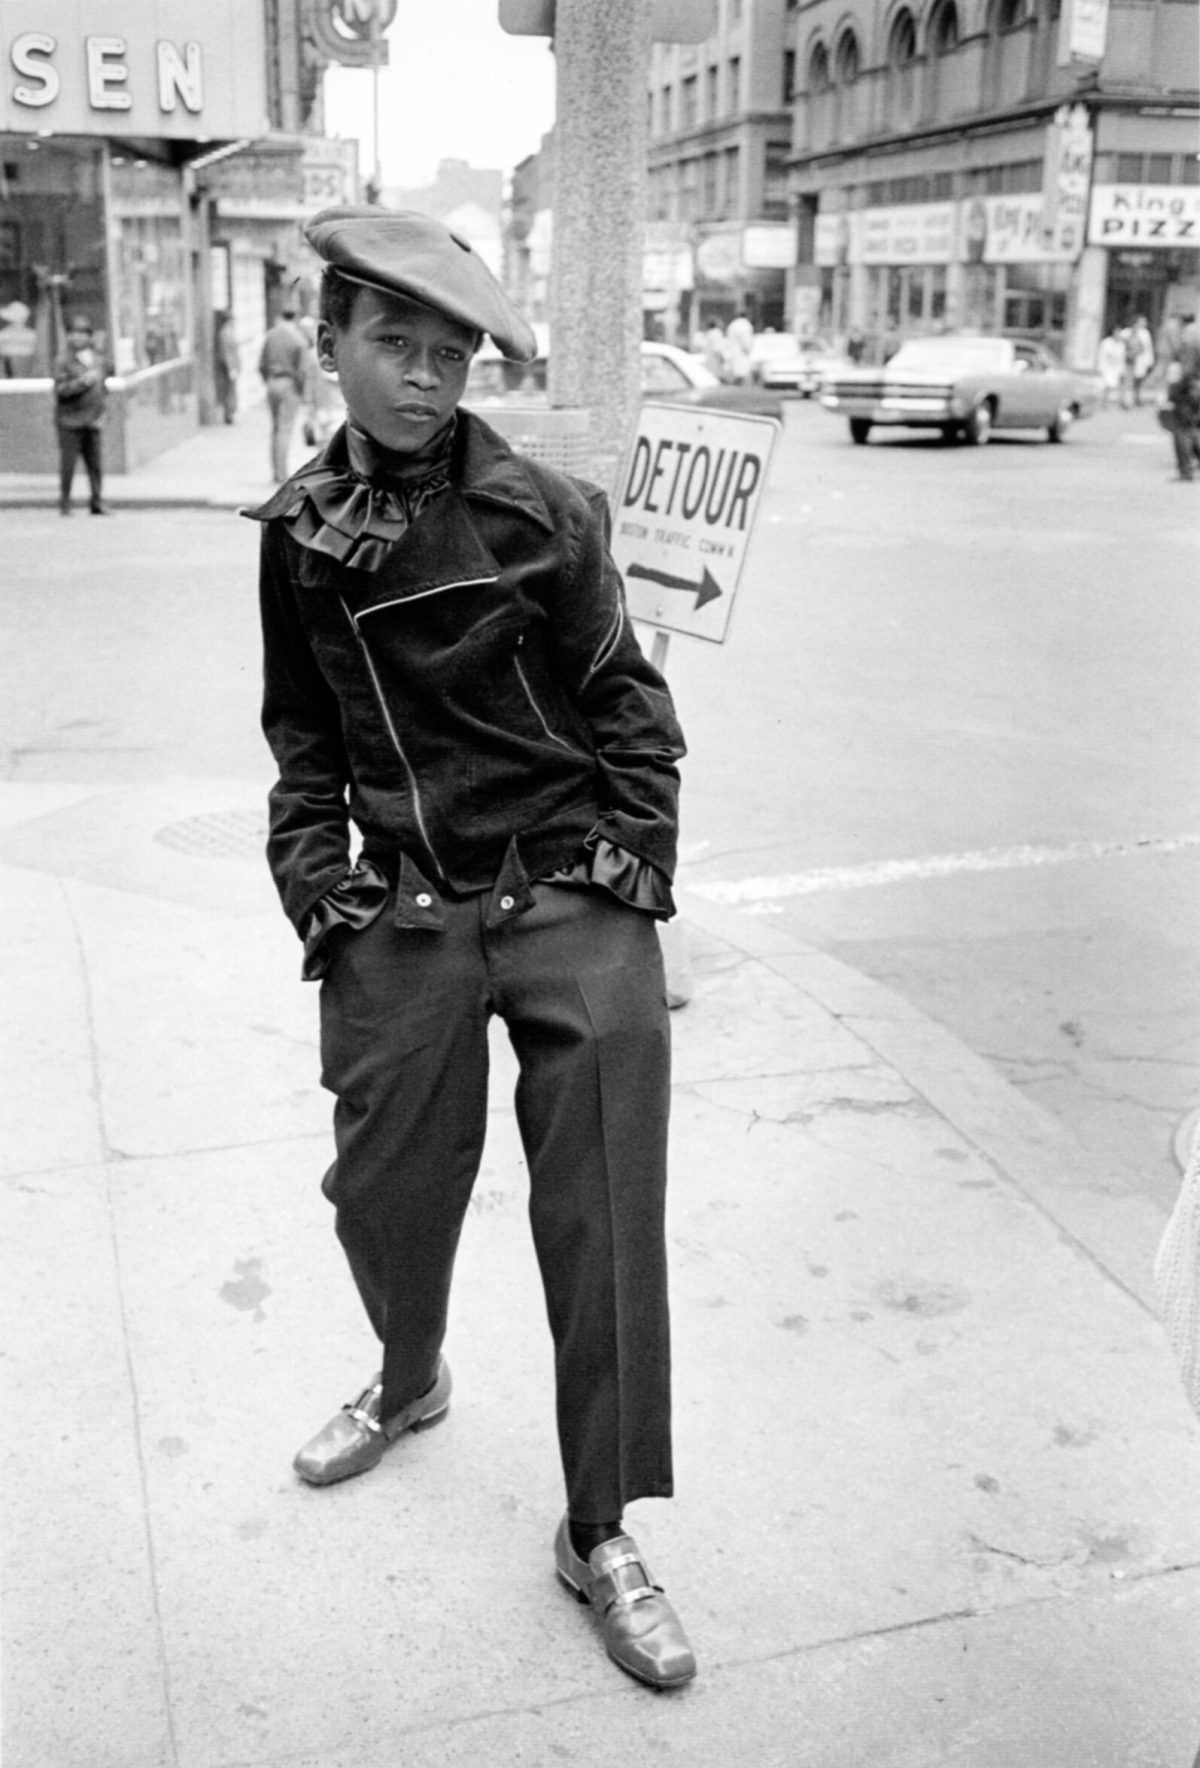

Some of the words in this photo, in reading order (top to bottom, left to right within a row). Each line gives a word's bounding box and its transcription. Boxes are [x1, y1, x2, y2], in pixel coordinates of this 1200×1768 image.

[11, 32, 202, 112] SEN
[1112, 191, 1185, 216] King
[623, 435, 761, 531] DETOUR
